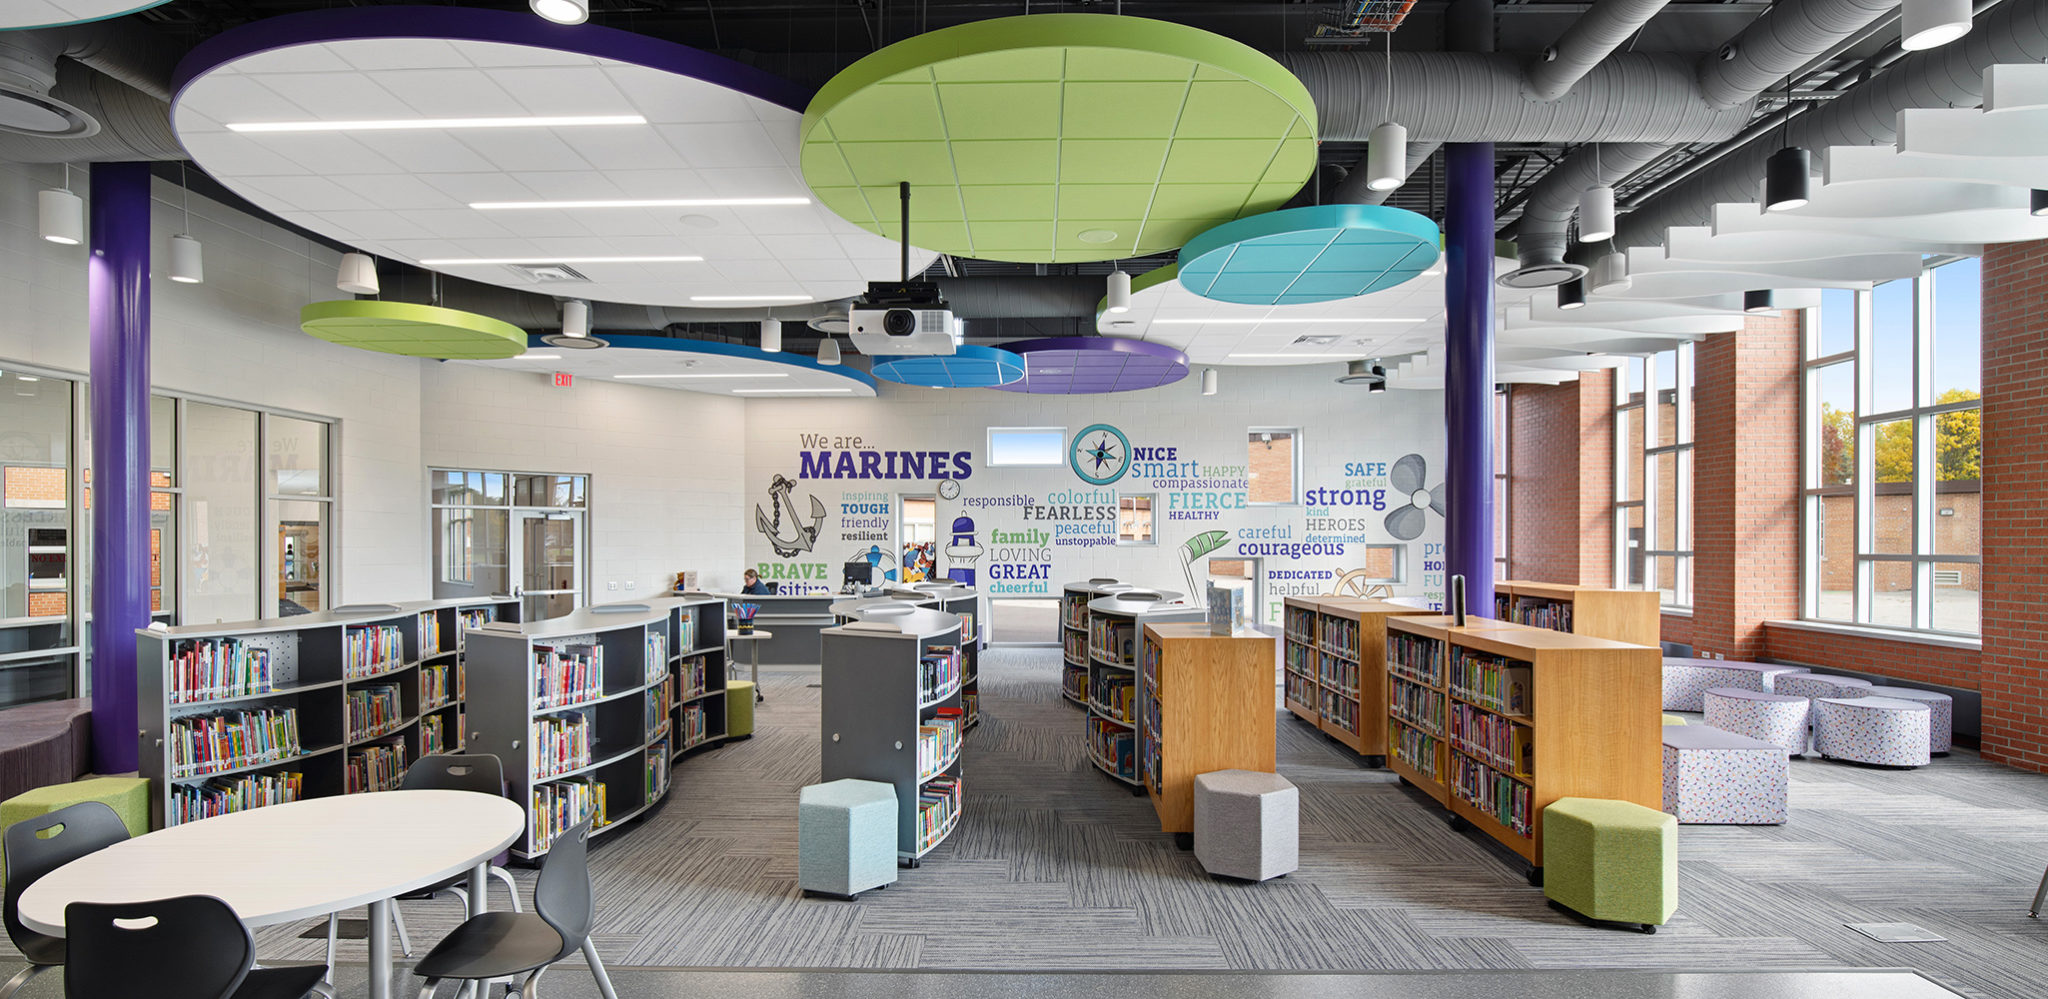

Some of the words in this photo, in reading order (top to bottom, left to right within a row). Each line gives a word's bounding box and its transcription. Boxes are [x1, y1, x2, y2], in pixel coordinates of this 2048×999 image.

[555, 373, 573, 387] EXIT
[800, 434, 828, 449] We
[834, 437, 874, 449] are...
[1134, 447, 1176, 461] NICE
[799, 451, 972, 479] MARINES
[1132, 460, 1199, 478] smart
[1203, 466, 1245, 478] HAPPY
[1345, 463, 1386, 476] SAFE
[1153, 477, 1248, 491] compassionate
[1346, 477, 1386, 488] grateful
[842, 491, 888, 503] inspiring
[964, 494, 1035, 508] responsible
[1048, 489, 1115, 504] colorful
[1169, 492, 1246, 509] FIERCE
[1306, 487, 1386, 511] strong
[841, 504, 889, 514] TOUGH
[1024, 505, 1116, 520] FEARLESS
[1169, 511, 1219, 520] HEALTHY
[1306, 507, 1329, 516] kind
[842, 517, 888, 529] friendly
[1056, 521, 1115, 536] peaceful
[1306, 519, 1365, 531] HEROES
[842, 531, 888, 540] resilient
[992, 528, 1050, 548] family
[1239, 525, 1291, 539] careful
[1306, 533, 1365, 543] determined
[1056, 536, 1116, 547] unstoppable
[990, 548, 1051, 561] LOVING
[1239, 543, 1344, 559] courageous
[757, 563, 827, 579] BRAVE
[989, 564, 1051, 579] GREAT
[1269, 571, 1332, 579] DEDICATED
[990, 581, 1047, 593] cheerful
[1424, 575, 1443, 587] FU
[1269, 583, 1319, 597] helpful
